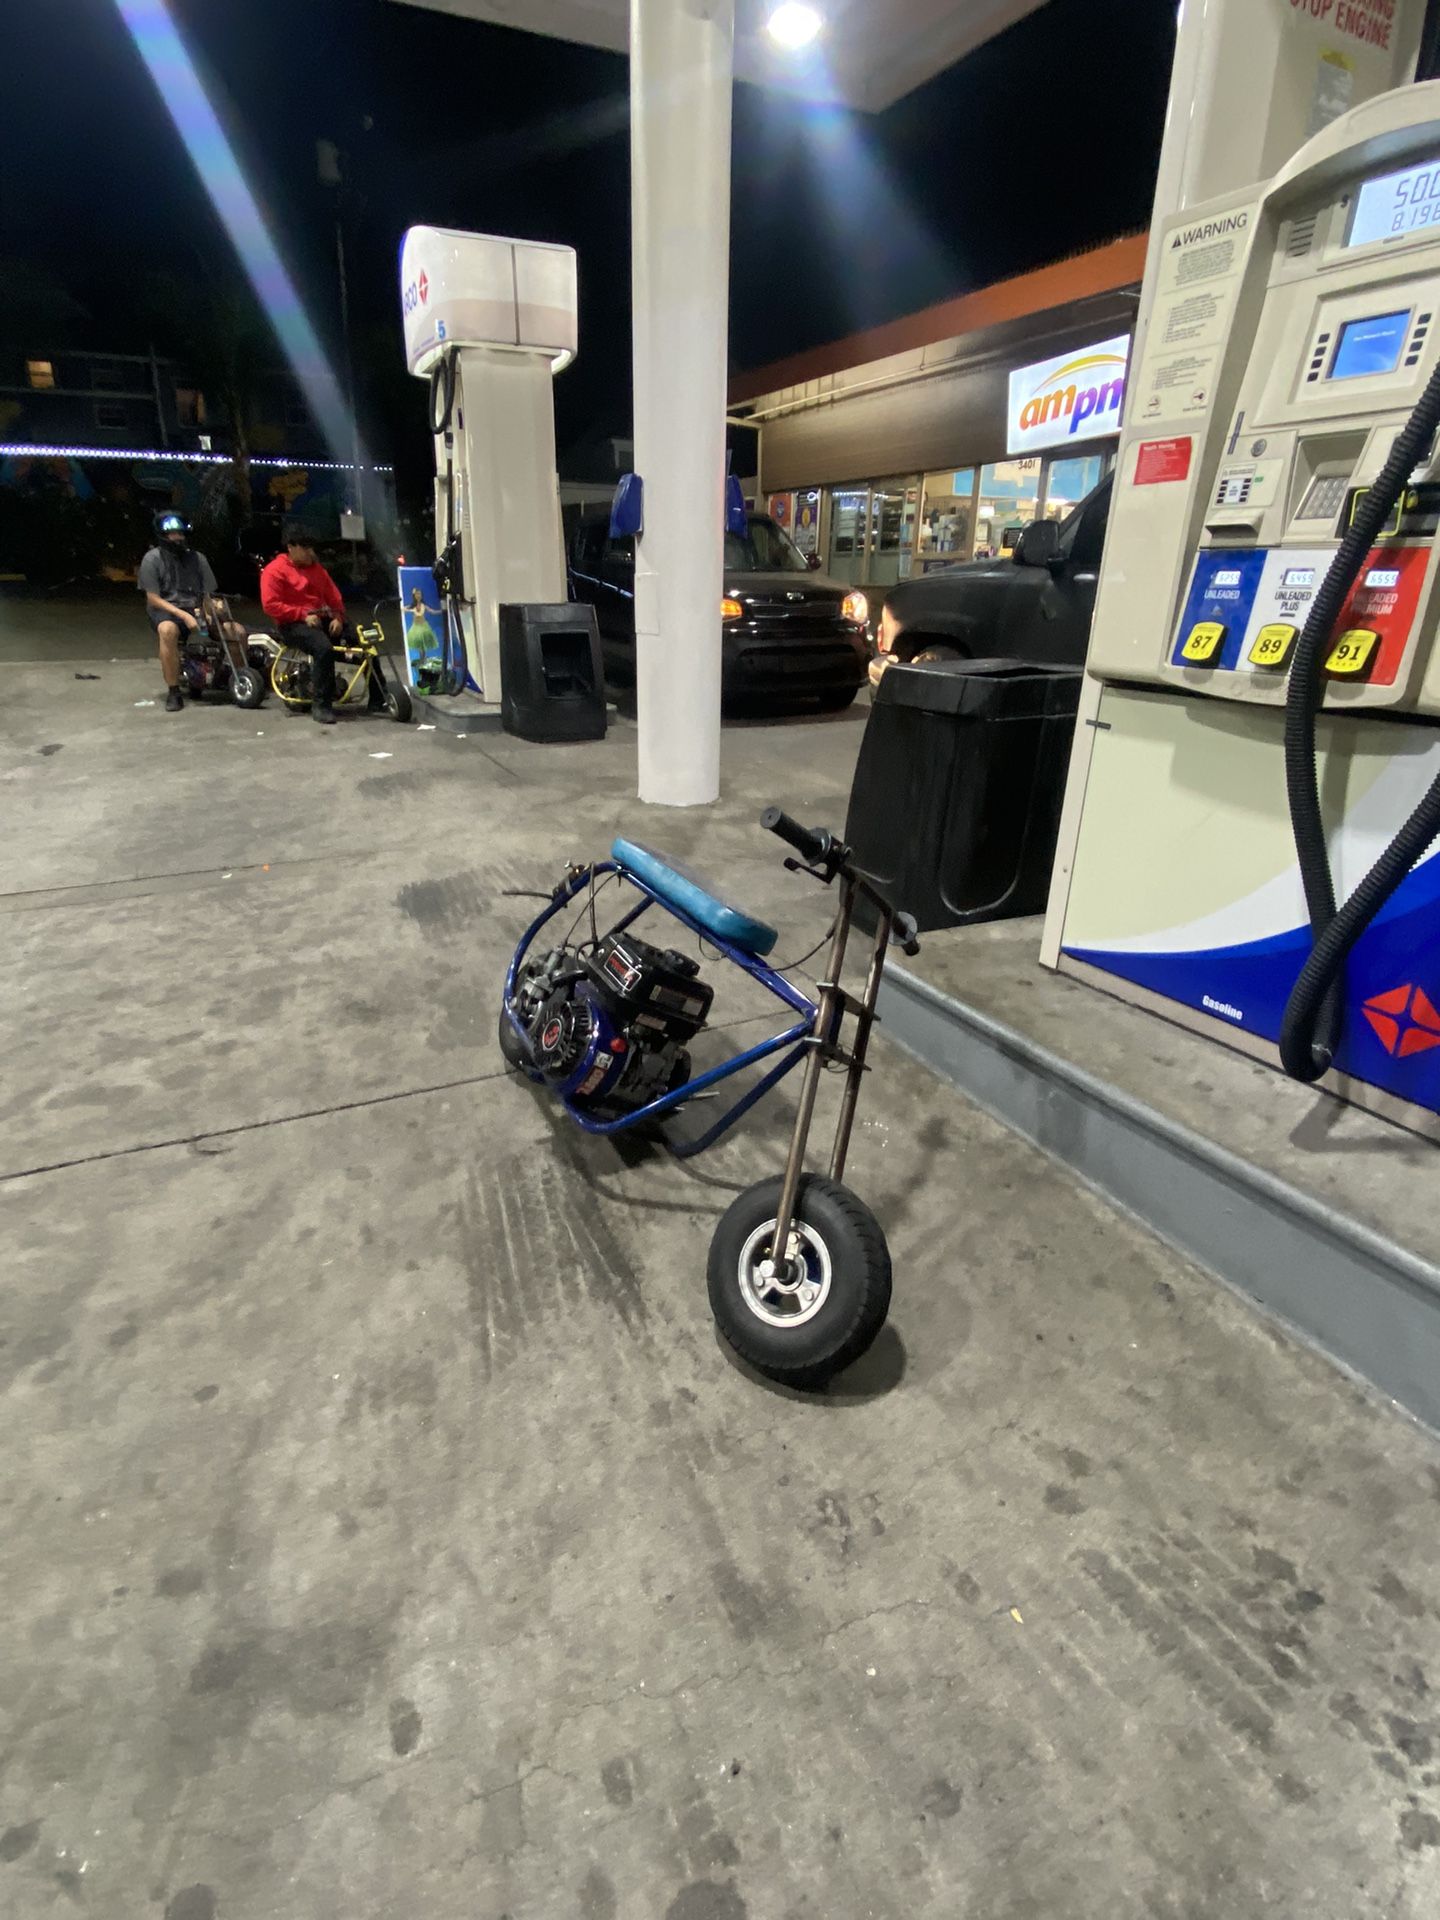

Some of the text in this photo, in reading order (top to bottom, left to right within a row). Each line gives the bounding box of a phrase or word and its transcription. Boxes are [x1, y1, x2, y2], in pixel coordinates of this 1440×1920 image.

[1290, 0, 1332, 19] OP
[1335, 3, 1392, 50] ENGINE
[1183, 213, 1247, 245] WARNING
[437, 319, 446, 340] 5
[1018, 459, 1036, 471] 3401
[1204, 588, 1241, 600] UNLEADED
[1275, 591, 1312, 601] UNLEADED
[1352, 592, 1399, 604] EADED
[1280, 602, 1300, 611] PLUS
[1349, 603, 1394, 615] MIUM
[1191, 635, 1212, 650] 87
[1259, 639, 1283, 654] 89
[1337, 644, 1361, 661] 91
[1202, 994, 1243, 1020] Gasoline
